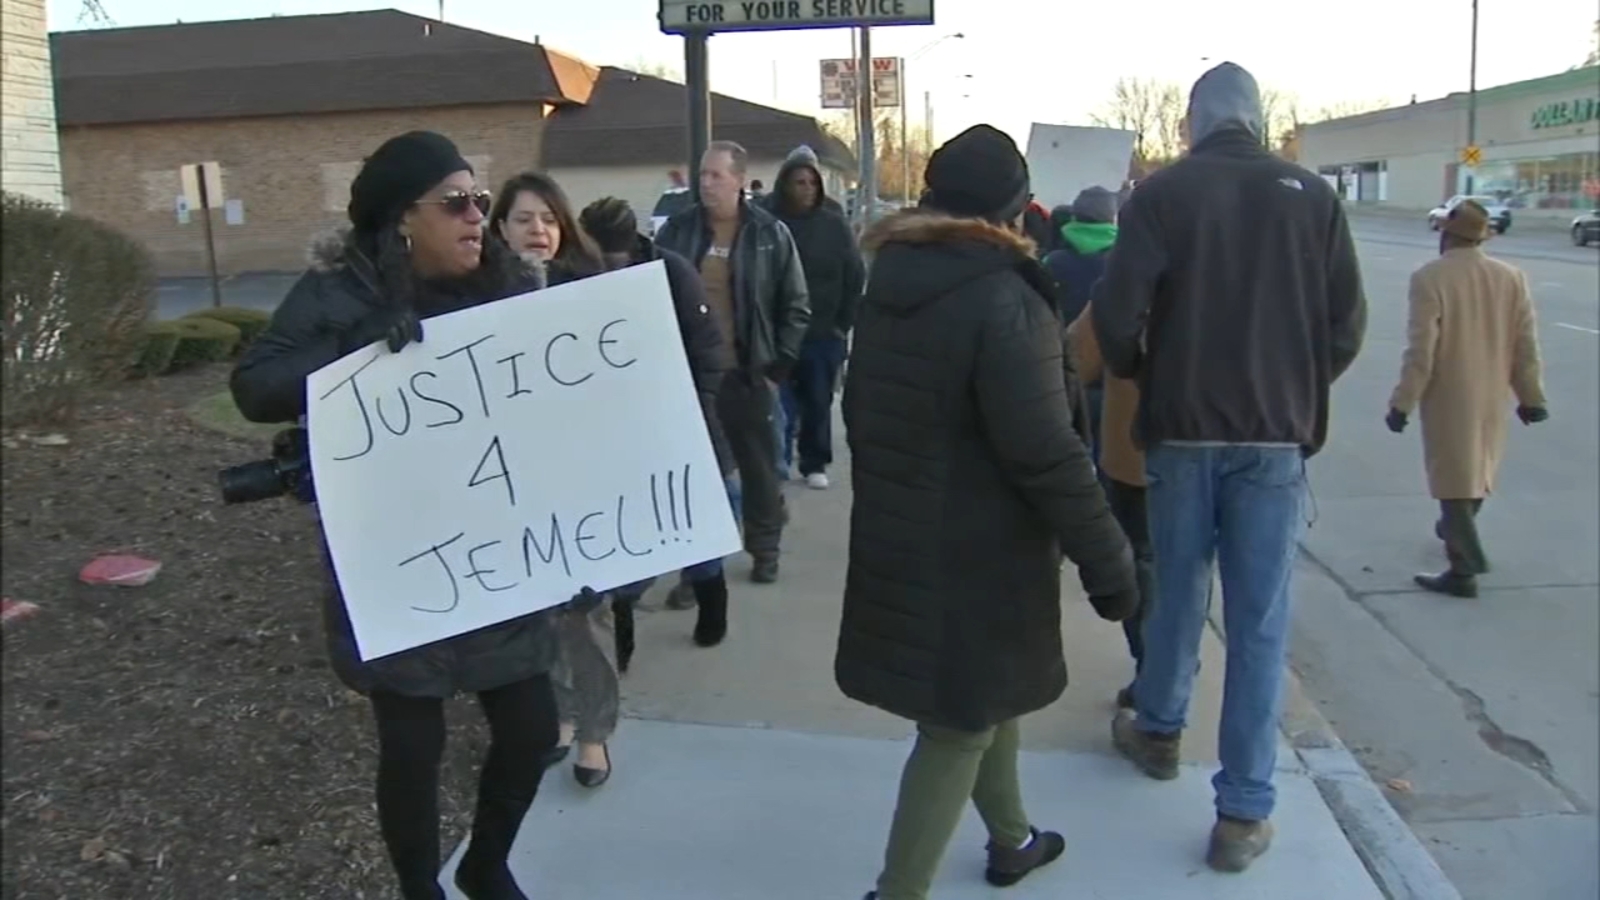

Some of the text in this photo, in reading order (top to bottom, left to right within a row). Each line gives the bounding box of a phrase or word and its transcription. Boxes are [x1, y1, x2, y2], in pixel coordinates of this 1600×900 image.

[686, 0, 905, 22] FOR YOUR SERVICE
[319, 318, 637, 461] JUSTICE
[467, 435, 515, 506] 4
[398, 463, 693, 614] JEMEL!!!
